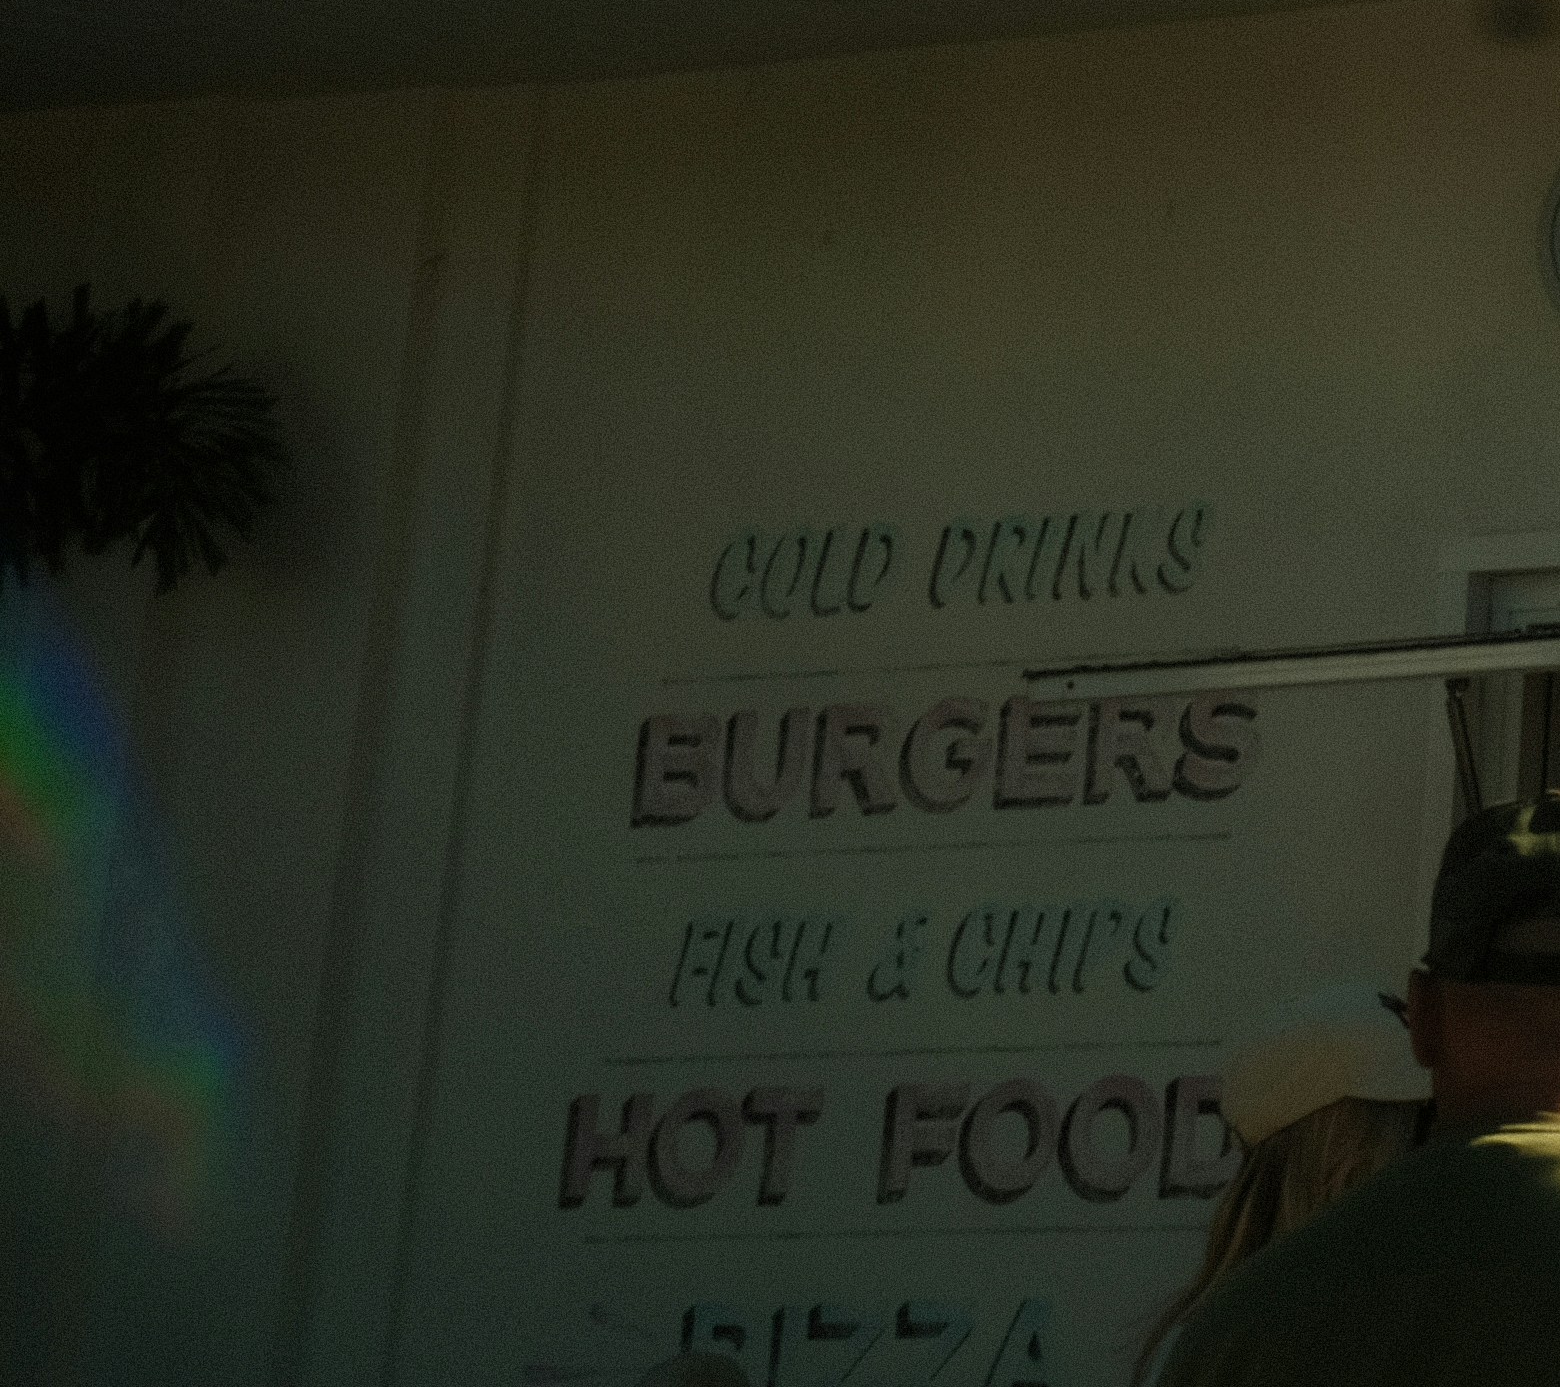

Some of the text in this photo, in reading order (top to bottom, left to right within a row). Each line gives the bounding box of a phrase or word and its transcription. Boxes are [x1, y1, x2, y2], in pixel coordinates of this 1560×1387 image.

[708, 498, 1216, 624] COLD DRINKS
[629, 693, 1259, 828] BURGERS
[667, 893, 1184, 1009] FISH & CHIPS
[557, 1073, 1240, 1210] HOT FOOD
